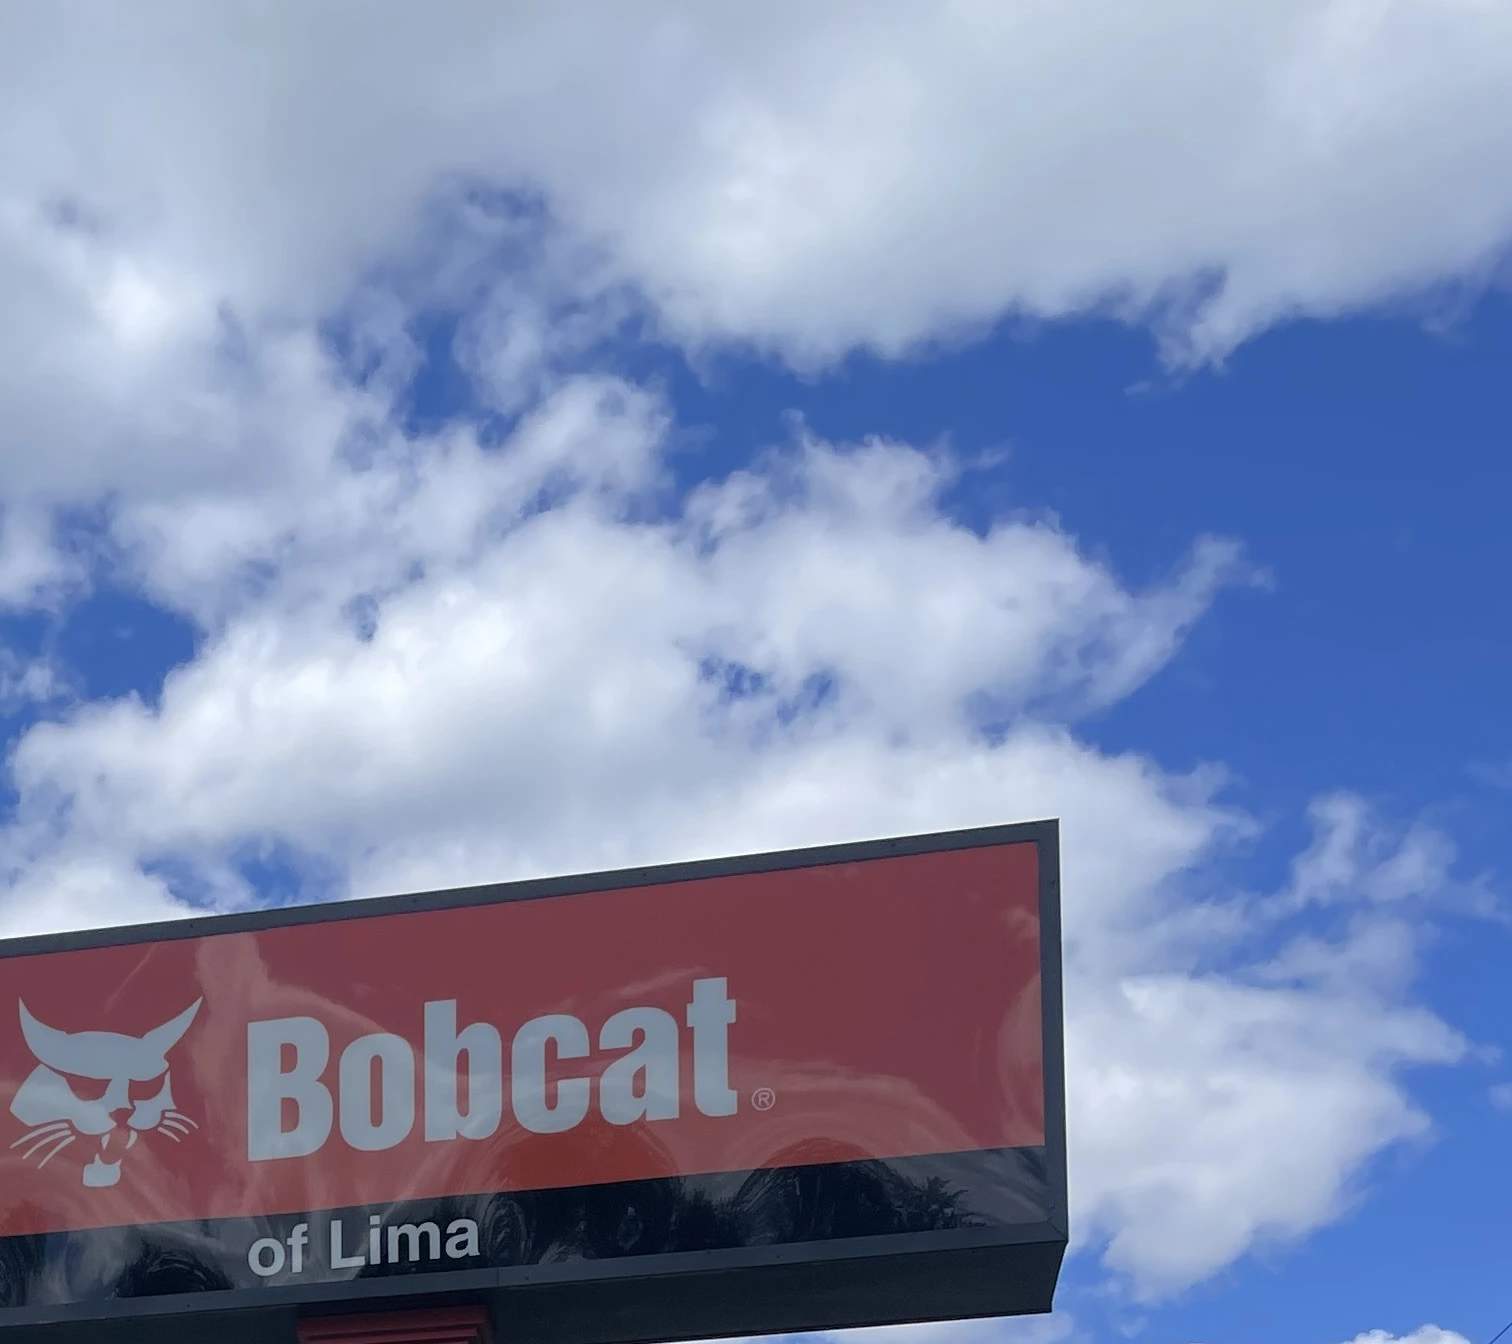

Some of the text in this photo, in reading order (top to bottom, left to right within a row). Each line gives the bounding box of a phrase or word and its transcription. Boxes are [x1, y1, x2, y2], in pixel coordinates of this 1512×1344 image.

[247, 976, 738, 1162] Bobcat
[247, 1214, 482, 1277] of Lima
